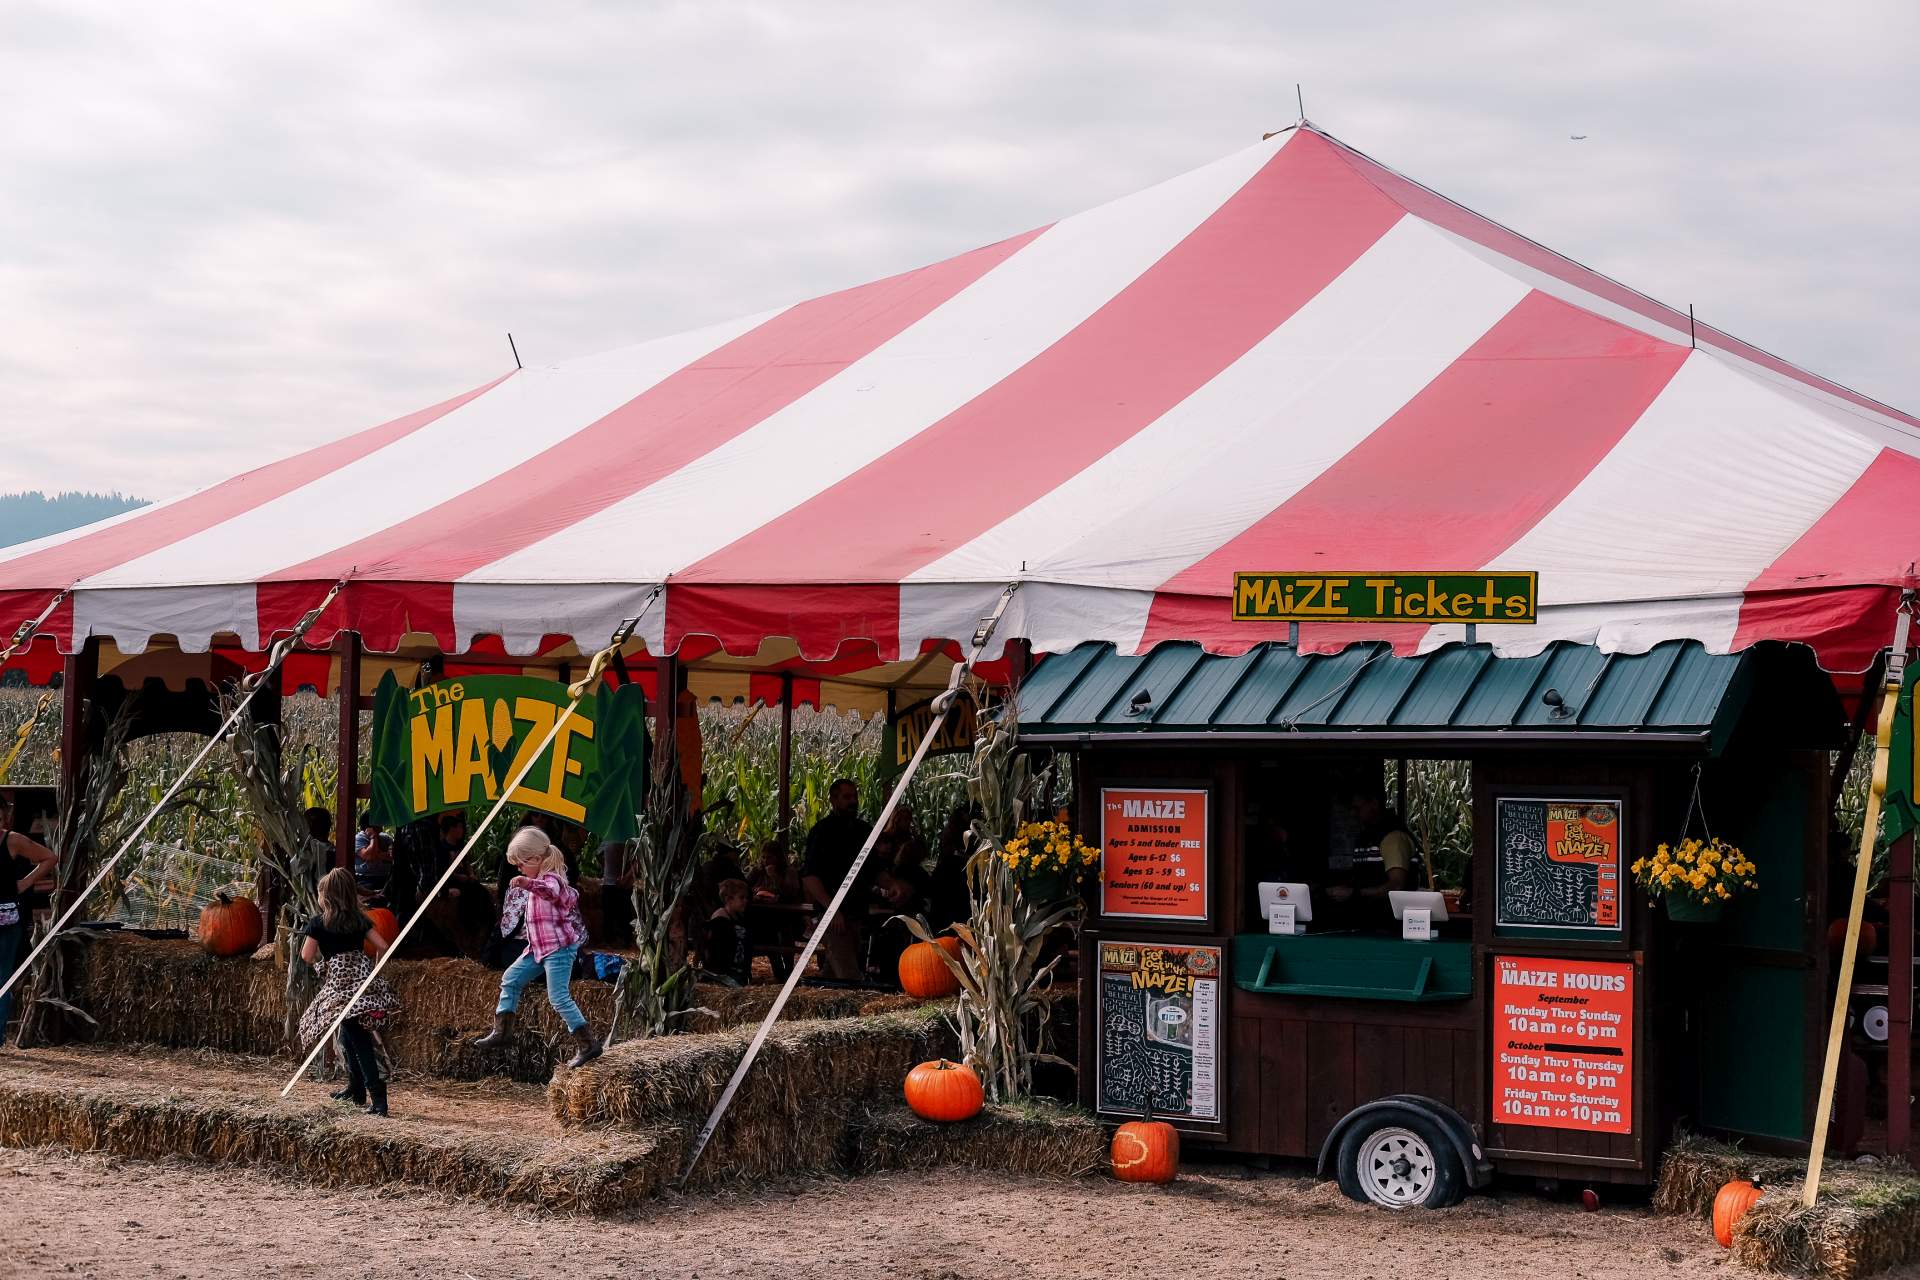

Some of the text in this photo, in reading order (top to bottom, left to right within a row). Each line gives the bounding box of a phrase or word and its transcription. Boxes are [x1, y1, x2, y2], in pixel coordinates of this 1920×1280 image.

[1239, 579, 1527, 616] MAiZE Tickets
[410, 682, 464, 714] The
[1106, 800, 1186, 818] The MAiZE
[1128, 824, 1181, 834] ADMISSION
[1564, 823, 1584, 833] Get
[1564, 830, 1585, 842] Lost
[1109, 838, 1129, 847] Ages
[1154, 840, 1180, 848] Under
[1180, 840, 1200, 848] FREE
[1128, 854, 1147, 862] Ages
[1170, 854, 1181, 863] $6
[1122, 867, 1142, 876] Ages
[1162, 868, 1172, 876] 59
[1109, 880, 1139, 890] Seniors
[1156, 882, 1171, 890] and
[1189, 882, 1200, 892] $6
[1141, 948, 1163, 960] Get
[1140, 957, 1166, 970] Lost
[1501, 970, 1626, 992] MAiZE HOURS
[1538, 993, 1589, 1005] September
[1504, 1004, 1621, 1024] Monday Thru Sunday
[1561, 1024, 1574, 1033] to
[1508, 1040, 1544, 1051] October
[1500, 1053, 1624, 1074] Sunday Thru Thursday
[1560, 1074, 1572, 1083] to
[1504, 1088, 1619, 1108] Friday Thru Saturday
[1555, 1108, 1567, 1117] to
